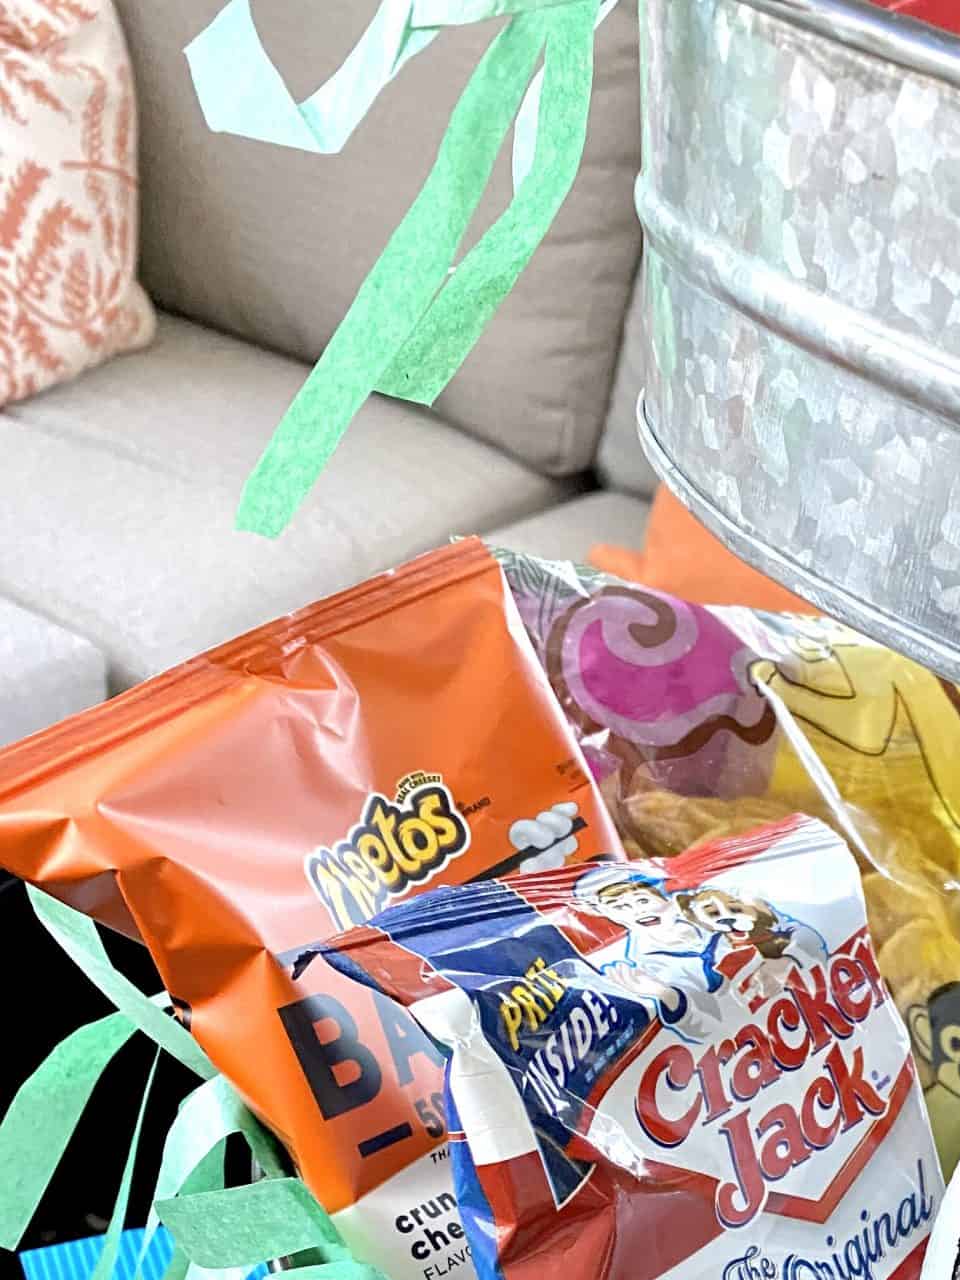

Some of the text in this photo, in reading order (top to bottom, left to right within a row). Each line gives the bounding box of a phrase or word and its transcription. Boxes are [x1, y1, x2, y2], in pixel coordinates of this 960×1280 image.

[634, 940, 886, 1150] Cracker
[715, 1042, 886, 1230] Jack
[395, 1192, 459, 1234] crun
[411, 1222, 465, 1261] che
